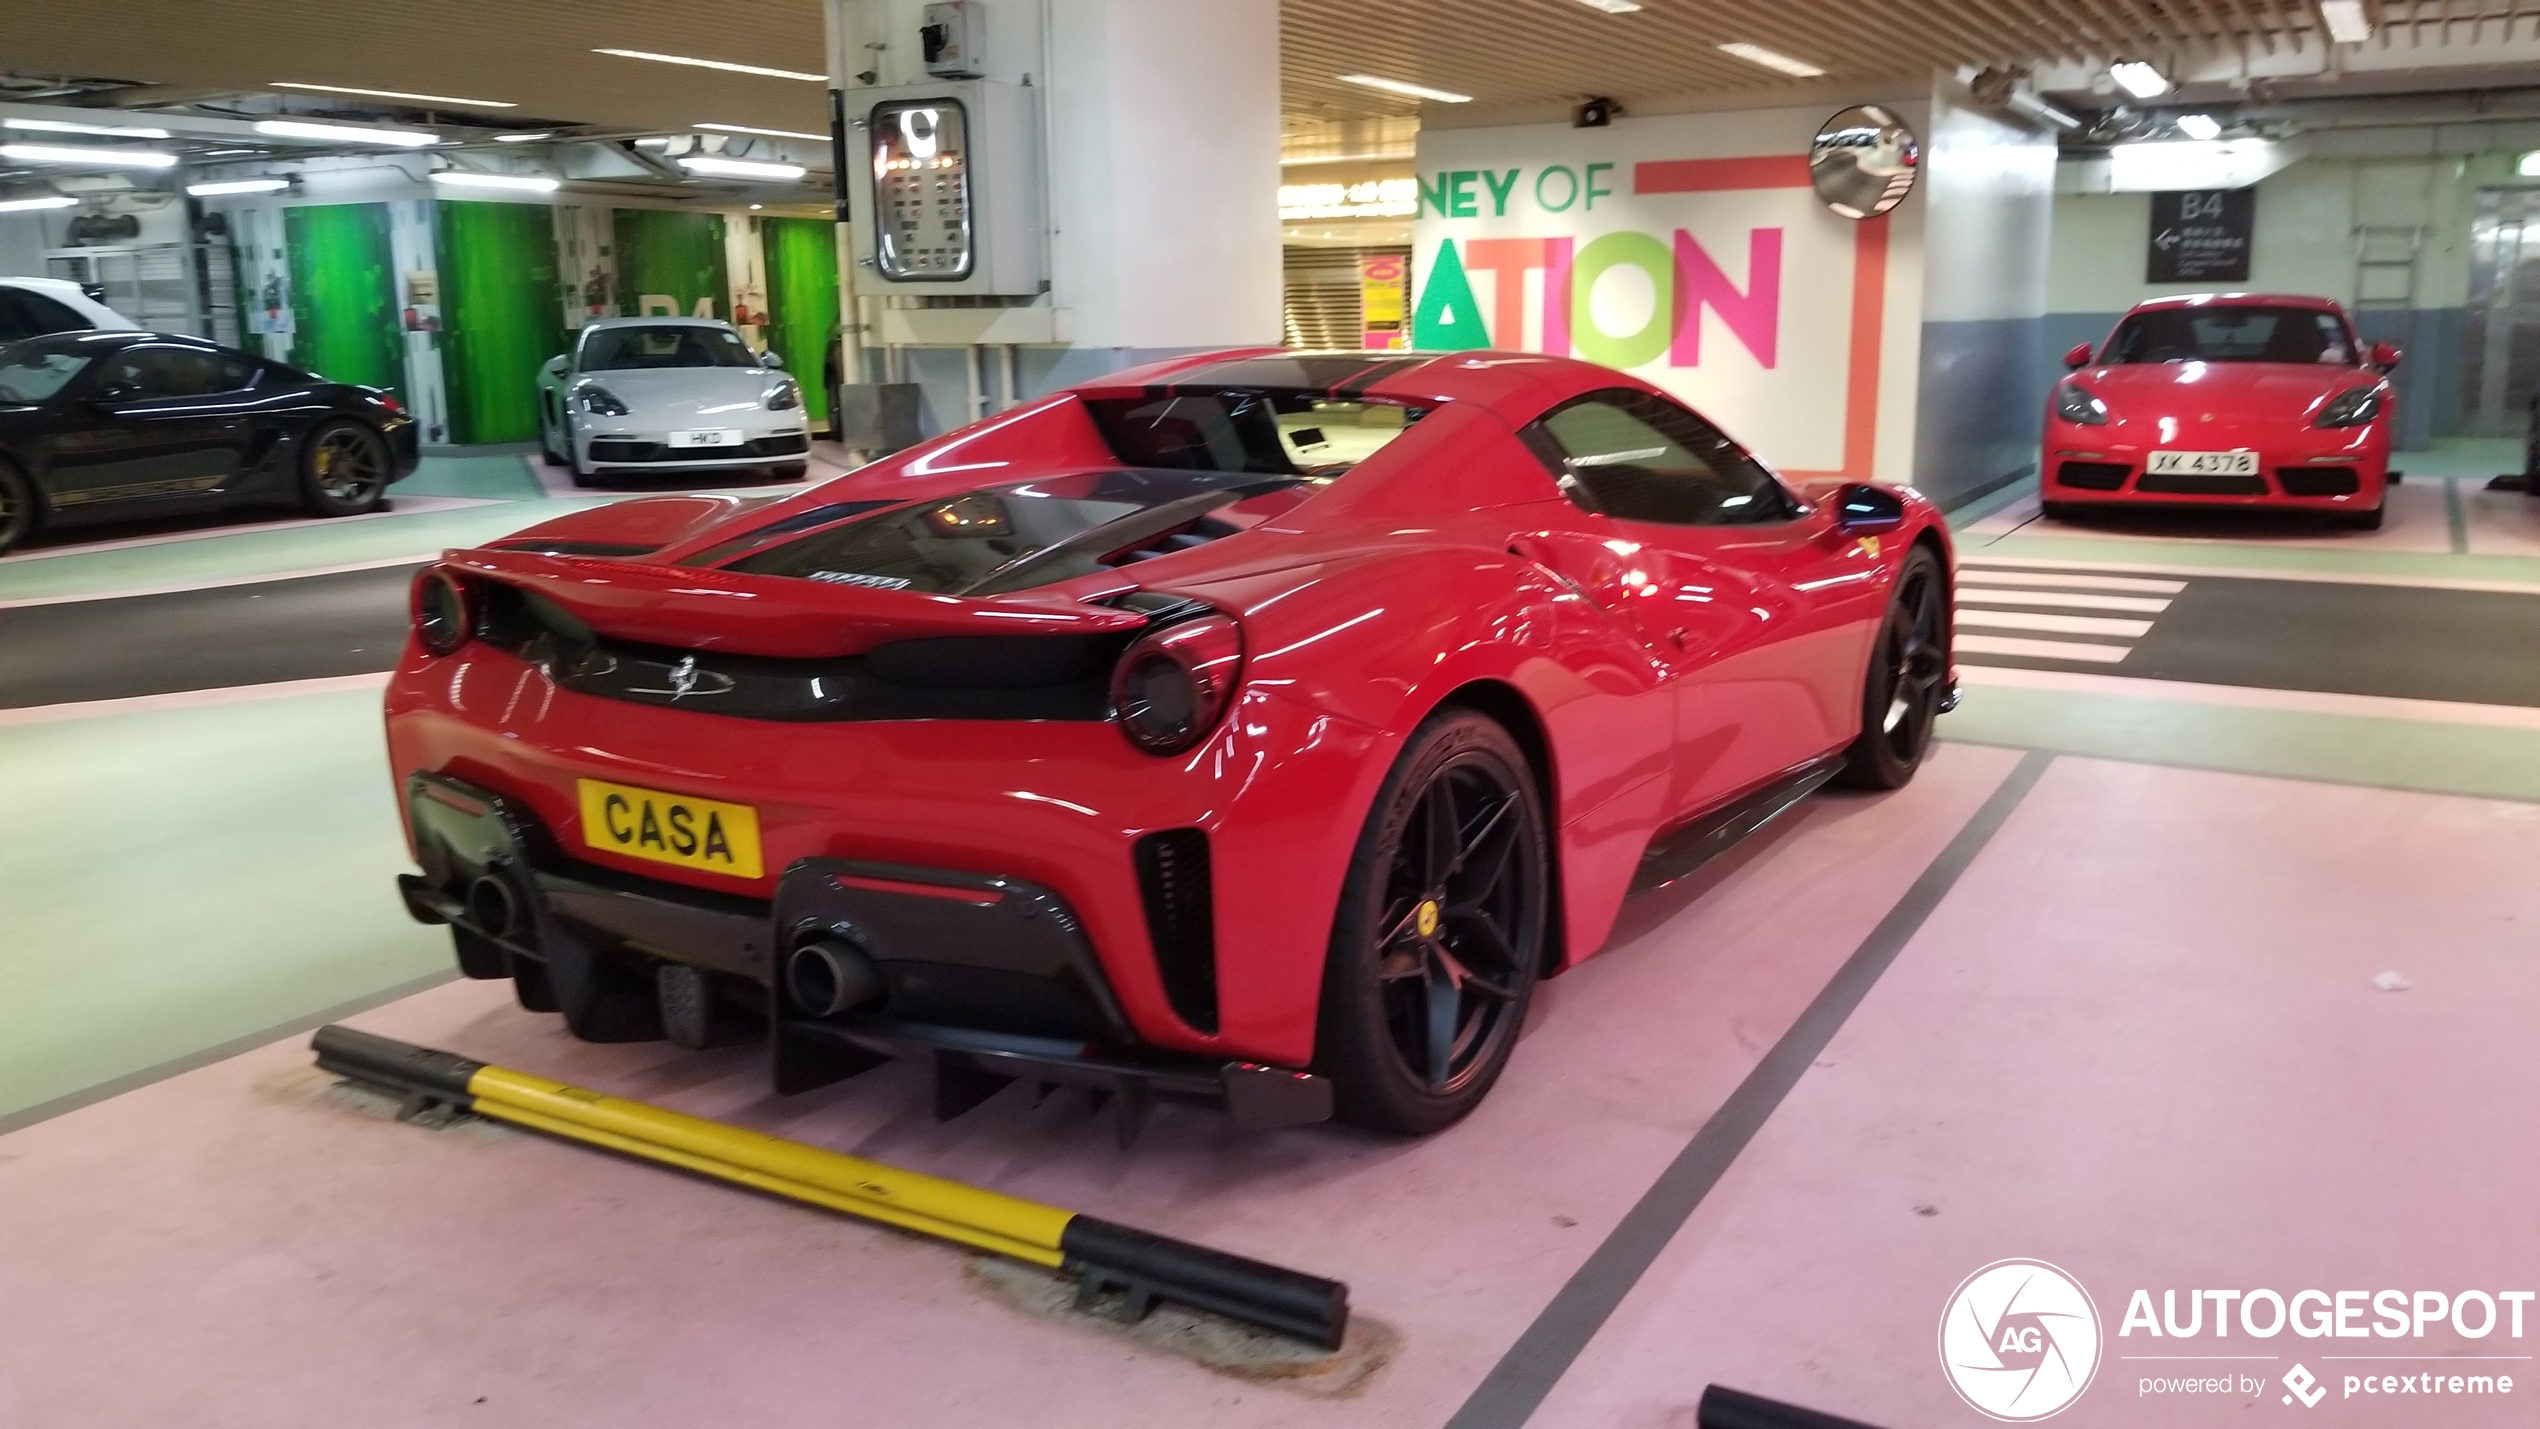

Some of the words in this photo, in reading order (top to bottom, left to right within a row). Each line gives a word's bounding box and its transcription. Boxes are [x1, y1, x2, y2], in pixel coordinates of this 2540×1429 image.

[1536, 163, 1613, 212] OF
[2181, 192, 2224, 219] B4
[1413, 228, 1782, 369] ATION
[2156, 455, 2183, 470] XK
[2192, 455, 2250, 472] 4378
[605, 793, 733, 863] CASA
